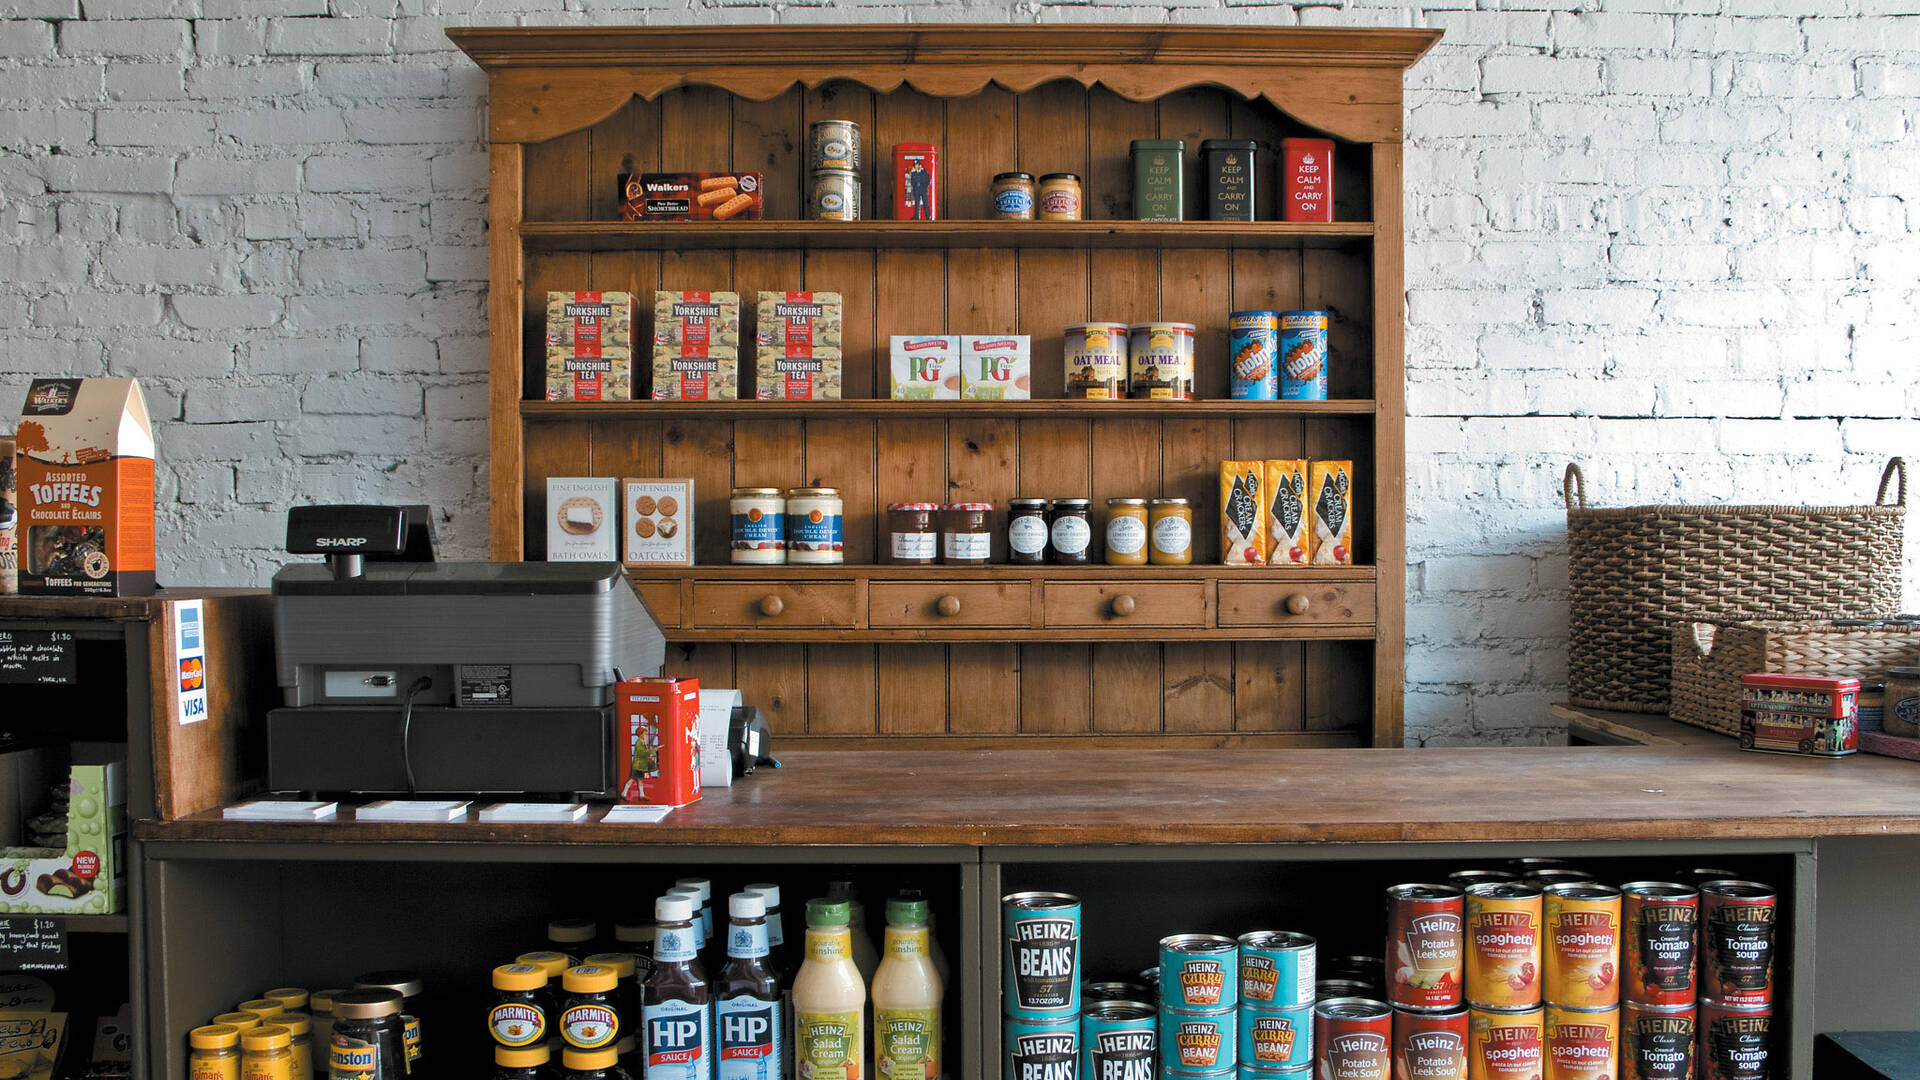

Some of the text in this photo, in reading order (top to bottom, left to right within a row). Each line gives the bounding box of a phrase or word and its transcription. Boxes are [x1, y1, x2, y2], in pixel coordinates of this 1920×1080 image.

[1150, 166, 1169, 174] KEEP
[1222, 166, 1242, 174] KEEP
[1299, 166, 1319, 174] KEEP
[1147, 176, 1172, 184] CALM
[1220, 176, 1244, 184] CALM
[1297, 176, 1320, 184] CALM
[646, 183, 689, 192] Walkers
[1146, 192, 1174, 201] CARRY
[1218, 192, 1245, 200] CARRY
[1295, 192, 1323, 200] CARRY
[1224, 203, 1240, 211] ON
[1302, 203, 1316, 211] ON
[566, 306, 611, 316] YORKSHIRE
[674, 306, 719, 316] YORKSHIRE
[776, 305, 822, 316] YORKSHIRE
[581, 317, 595, 325] TEA
[689, 316, 704, 324] TEA
[792, 316, 806, 324] TEA
[566, 361, 611, 371] YORKSHIRE
[672, 360, 717, 371] YORKSHIRE
[776, 361, 821, 371] YORKSHIRE
[1074, 356, 1121, 365] OAT MEAL
[1138, 356, 1156, 365] OAT
[909, 357, 939, 382] PG
[980, 356, 1010, 382] PG
[581, 372, 595, 380] TEA
[687, 371, 702, 379] TEA
[45, 472, 87, 482] ASSORTED
[30, 483, 102, 508] TOFFEES
[1234, 488, 1245, 531] CRACKERS
[1243, 496, 1252, 525] CREAM
[1280, 488, 1291, 530] CRACKERS
[1289, 495, 1298, 524] CREAM
[1324, 486, 1335, 529] CRACKERS
[1333, 494, 1342, 523] CREAM
[31, 509, 70, 520] CHOCOLATE
[316, 538, 367, 547] SHARP
[552, 552, 608, 560] BATH OVALS
[629, 552, 685, 560] OATCAKES
[45, 577, 72, 586] TOFFEES
[183, 698, 204, 716] VISA
[76, 856, 96, 864] NEW
[1483, 914, 1530, 926] HEINZ
[1560, 914, 1609, 927] HEINZ
[1645, 908, 1692, 923] HEINZ
[1724, 908, 1771, 922] HEINZ
[1021, 924, 1071, 940] HEINZ
[1421, 920, 1456, 933] Heinz
[1421, 939, 1455, 948] Potato &
[1476, 933, 1533, 946] spaghetti
[1556, 932, 1613, 946] spaghetti
[1648, 939, 1689, 950] Tomato
[1726, 938, 1768, 950] Tomato
[1417, 949, 1457, 960] Leek Soup
[1658, 951, 1680, 960] soup
[1736, 950, 1759, 960] soup
[1020, 947, 1071, 977] BEANS
[1188, 962, 1217, 973] HEINZ
[1245, 958, 1270, 969] HEINZ
[1186, 986, 1220, 997] BEANZ
[1244, 980, 1273, 994] BEANZ
[494, 1007, 537, 1022] MARMITE
[567, 1008, 610, 1023] MARMITE
[724, 1016, 768, 1042] HP
[811, 1025, 845, 1036] HEINZ
[890, 1022, 923, 1033] HEINZ
[1185, 1025, 1214, 1034] HEINZ
[1260, 1020, 1287, 1030] HEINZ
[1640, 1020, 1688, 1034] HEINZ
[1726, 1019, 1769, 1033] HEINZ
[653, 1020, 697, 1047] HP
[1494, 1029, 1536, 1041] HEINZ
[1560, 1027, 1605, 1040] HEINZ
[813, 1038, 842, 1048] Salad
[892, 1034, 920, 1045] Salad
[1103, 1036, 1152, 1052] HEINZ
[1416, 1038, 1454, 1050] Heinz
[890, 1045, 922, 1054] Cream
[1023, 1039, 1072, 1055] HEINZ
[1257, 1042, 1289, 1054] BEANZ
[1341, 1039, 1378, 1052] Heinz
[661, 1053, 687, 1062] SAUCE
[732, 1048, 758, 1057] SAUCE
[812, 1049, 844, 1058] Cream
[1183, 1048, 1216, 1058] BEANZ
[1486, 1047, 1540, 1060] spaghetti
[1552, 1046, 1609, 1058] spaghetti
[1642, 1050, 1684, 1061] Tomato
[1728, 1050, 1767, 1061] Tomato
[332, 1051, 371, 1066] anston
[1342, 1058, 1377, 1068] Potato &
[1418, 1057, 1452, 1066] Potato &
[1023, 1060, 1072, 1080] BEANS
[1103, 1057, 1151, 1080] BEANS
[1652, 1062, 1676, 1072] soup
[1738, 1061, 1760, 1070] soup
[1338, 1068, 1380, 1079] Leek Soup
[1414, 1067, 1456, 1078] Leek Soup
